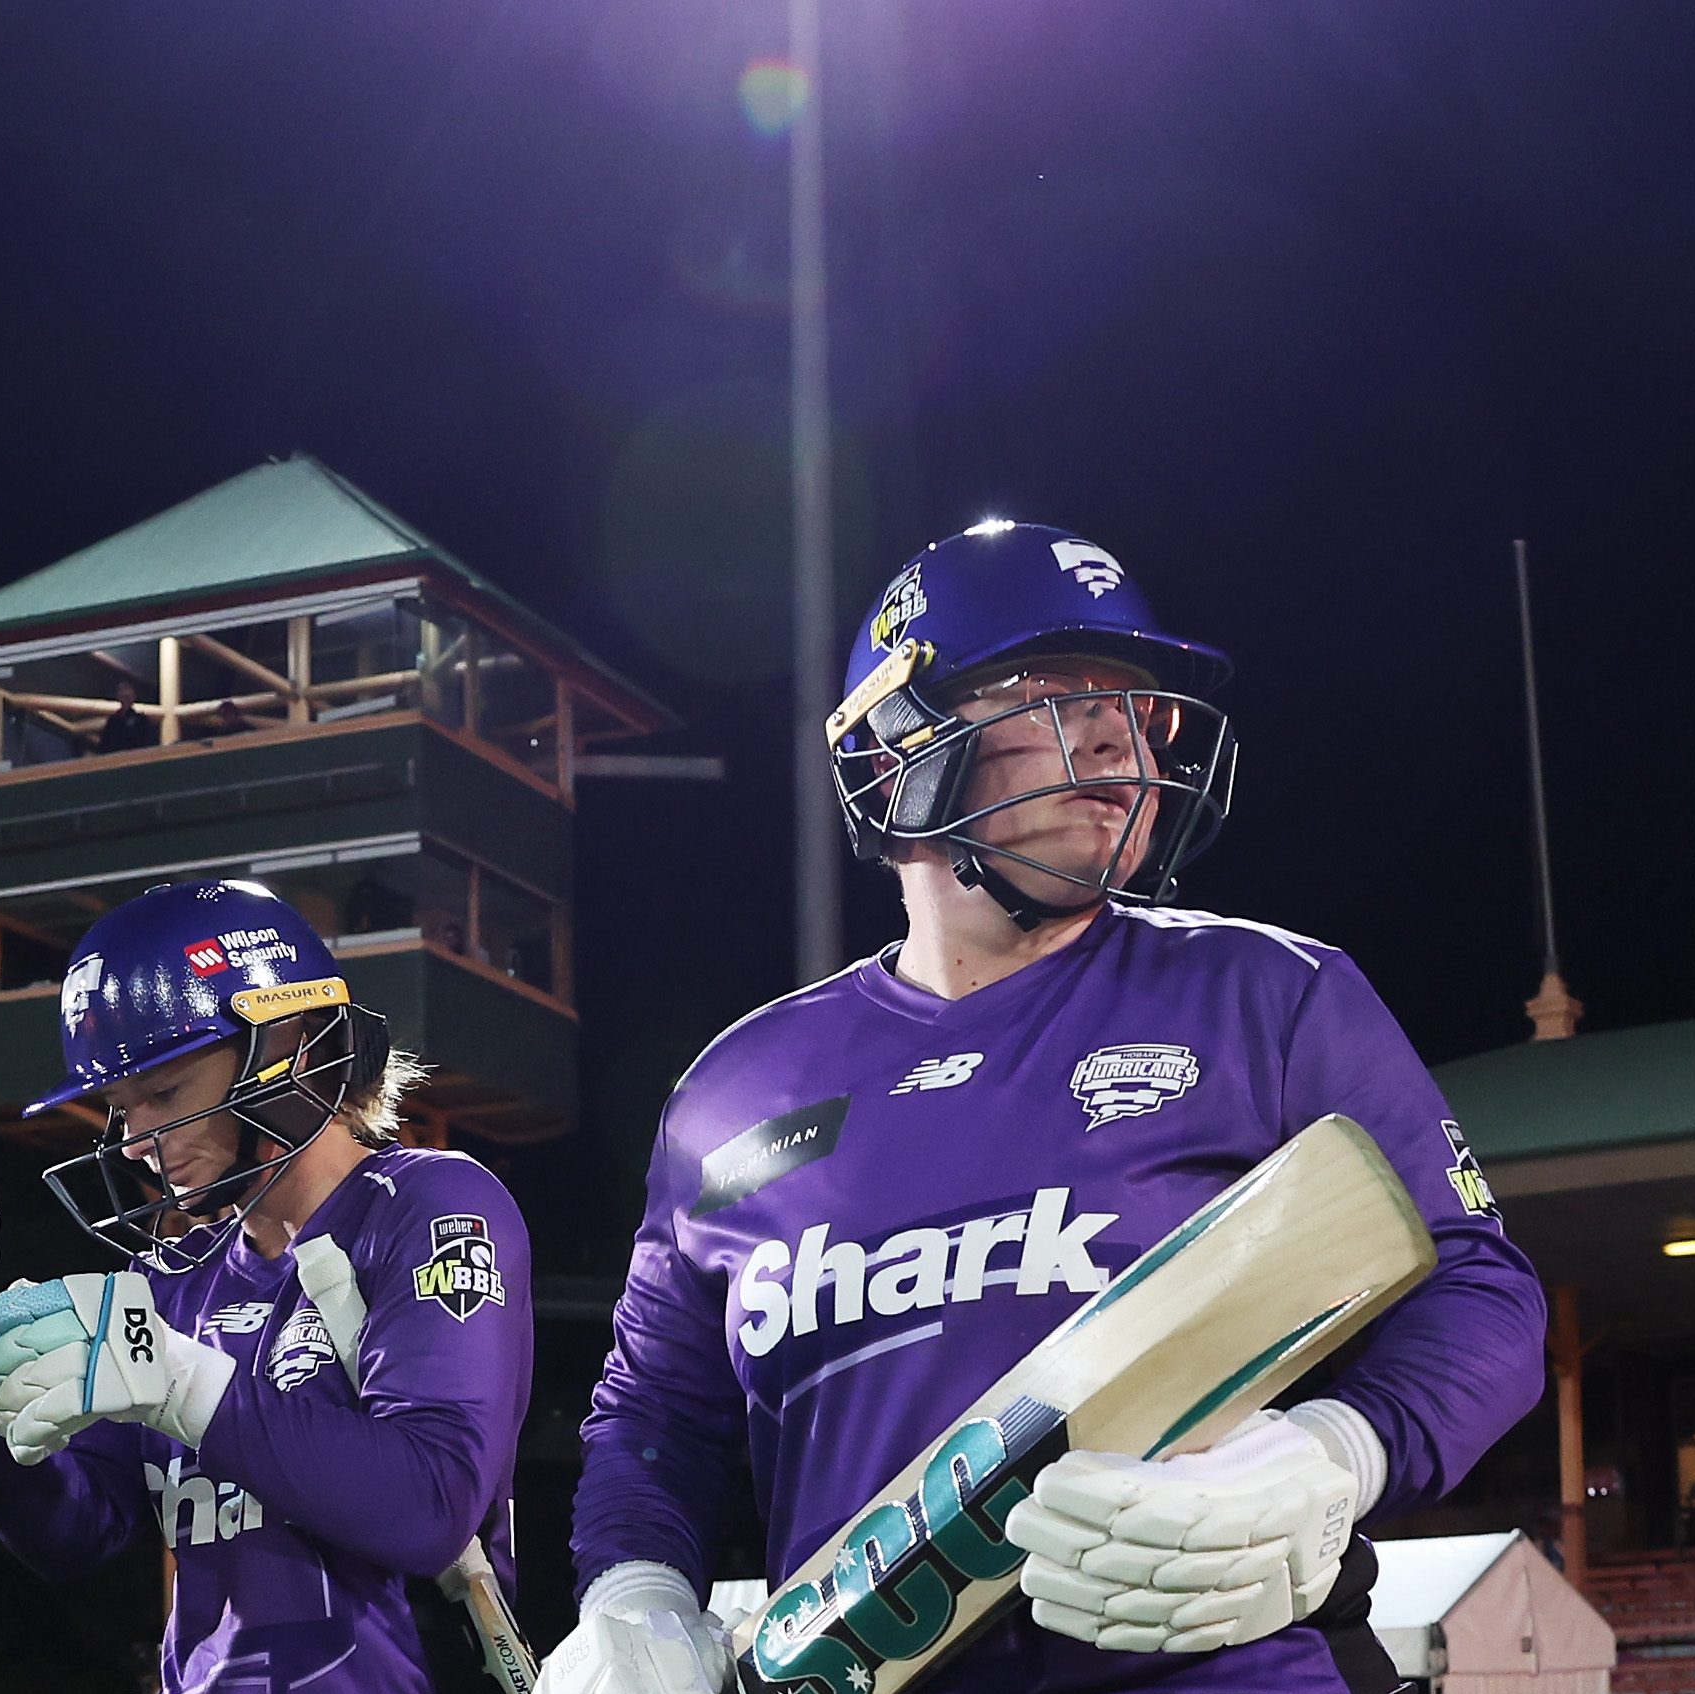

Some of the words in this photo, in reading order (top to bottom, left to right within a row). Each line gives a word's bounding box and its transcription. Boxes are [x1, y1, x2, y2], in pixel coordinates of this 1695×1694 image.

[872, 595, 927, 645] WBBL
[217, 927, 280, 951] Wilson
[227, 943, 297, 968] Security
[256, 986, 317, 1004] MASURI
[1074, 1060, 1200, 1084] HURRICANES
[718, 1126, 819, 1189] TASMANIAN
[438, 1218, 473, 1235] weber
[417, 1260, 504, 1300] WBBL
[738, 1187, 1120, 1357] Shark
[124, 1308, 154, 1364] DSC
[1319, 1497, 1348, 1559] SCC
